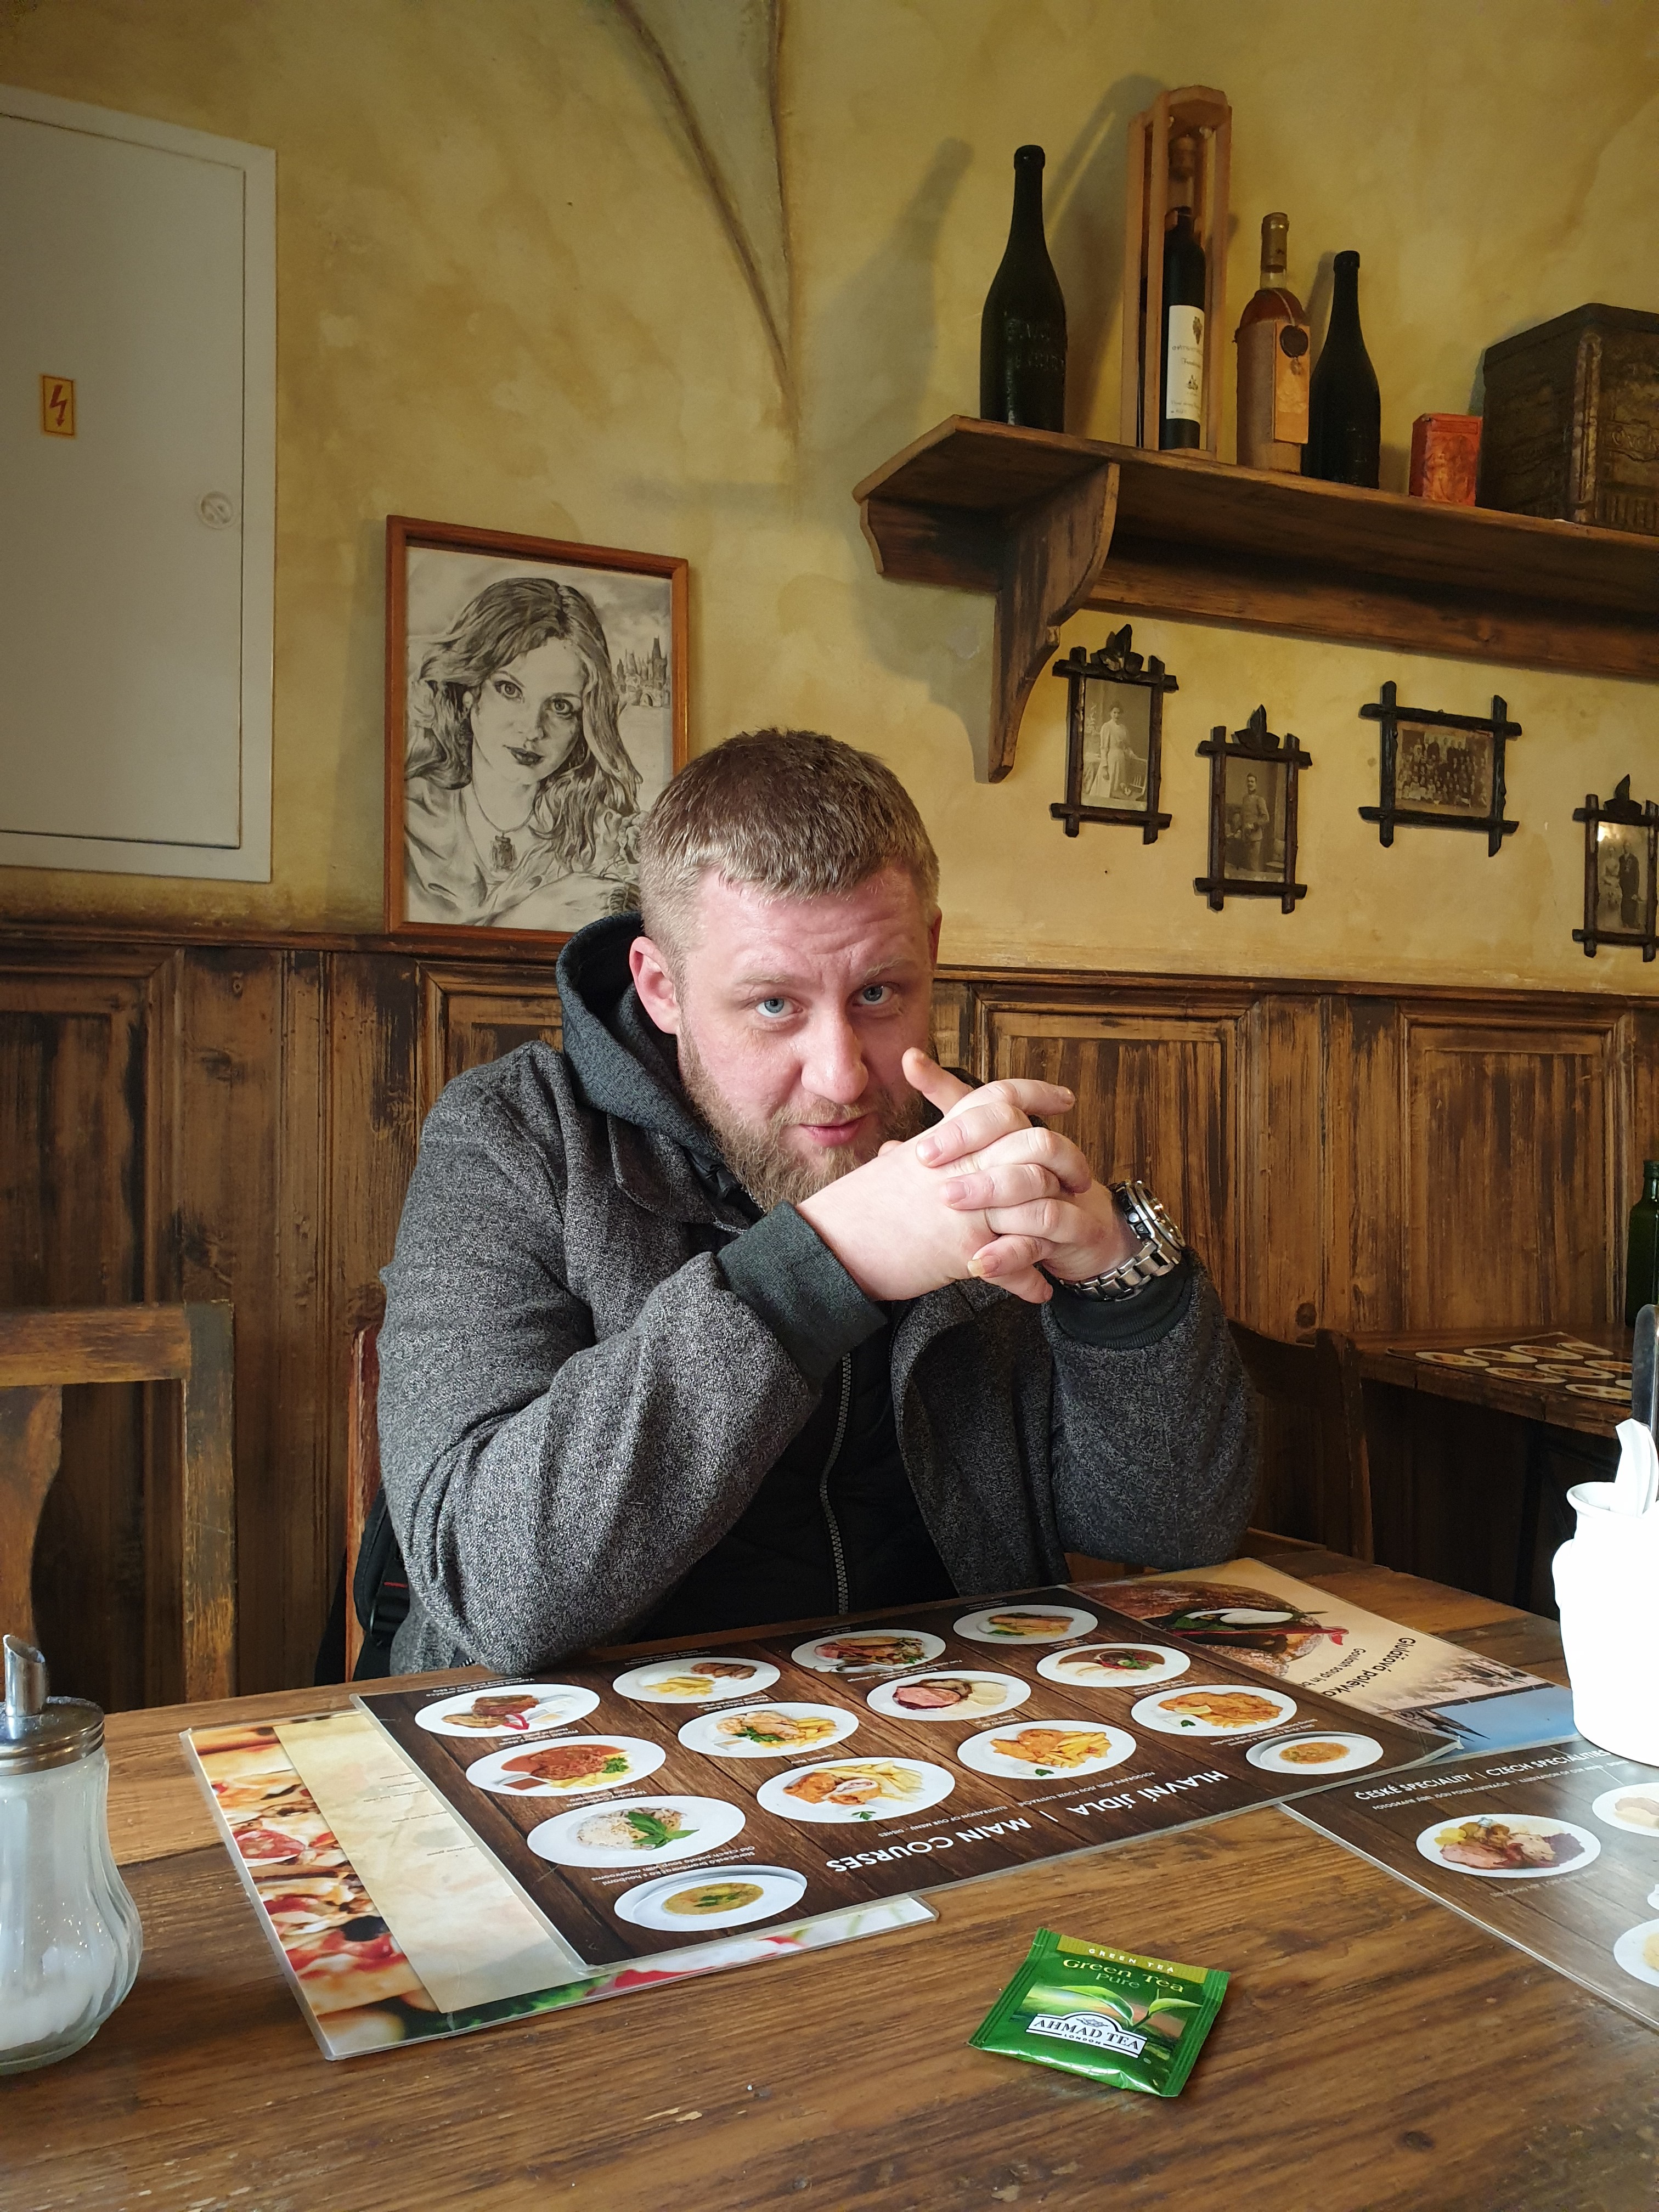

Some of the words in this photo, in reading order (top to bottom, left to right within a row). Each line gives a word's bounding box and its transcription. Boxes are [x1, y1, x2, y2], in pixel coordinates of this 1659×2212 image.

[1338, 1648, 1366, 1667] Goulash
[1319, 1667, 1343, 1678] soup
[1321, 1669, 1379, 1697] polévka
[1485, 1762, 1534, 1777] CZECH
[1530, 1749, 1612, 1768] SPECIALITIES
[1136, 1770, 1229, 1803] HLAVNÍ
[1354, 1784, 1403, 1801] ČESKÉ
[1399, 1773, 1475, 1792] SPECIALITY
[566, 1797, 610, 1807] Carbonara
[569, 1792, 613, 1802] Carbonara
[1066, 1793, 1137, 1816] JÍDLA
[961, 1805, 1008, 1820] ILLUSTRATION
[877, 1828, 905, 1838] DISHES
[909, 1822, 933, 1831] MENU
[955, 1818, 1032, 1843] MAIN
[684, 1854, 712, 1864] potato
[709, 1851, 755, 1865] Staročeská
[712, 1849, 738, 1858] czech
[826, 1836, 954, 1872] COURSES
[590, 1869, 641, 1882] mushrooms
[649, 1860, 708, 1877] bramboračka
[601, 1875, 642, 1886] houbami
[1088, 1948, 1137, 1964] GREEN
[1147, 1962, 1174, 1973] TEA
[1063, 1959, 1132, 1978] Green
[1142, 1974, 1184, 1993] Tea
[1096, 1973, 1140, 1988] Pure
[1033, 2019, 1103, 2039] AHMAD
[1106, 2032, 1139, 2051] TEA
[1064, 2034, 1102, 2045] LONDON
